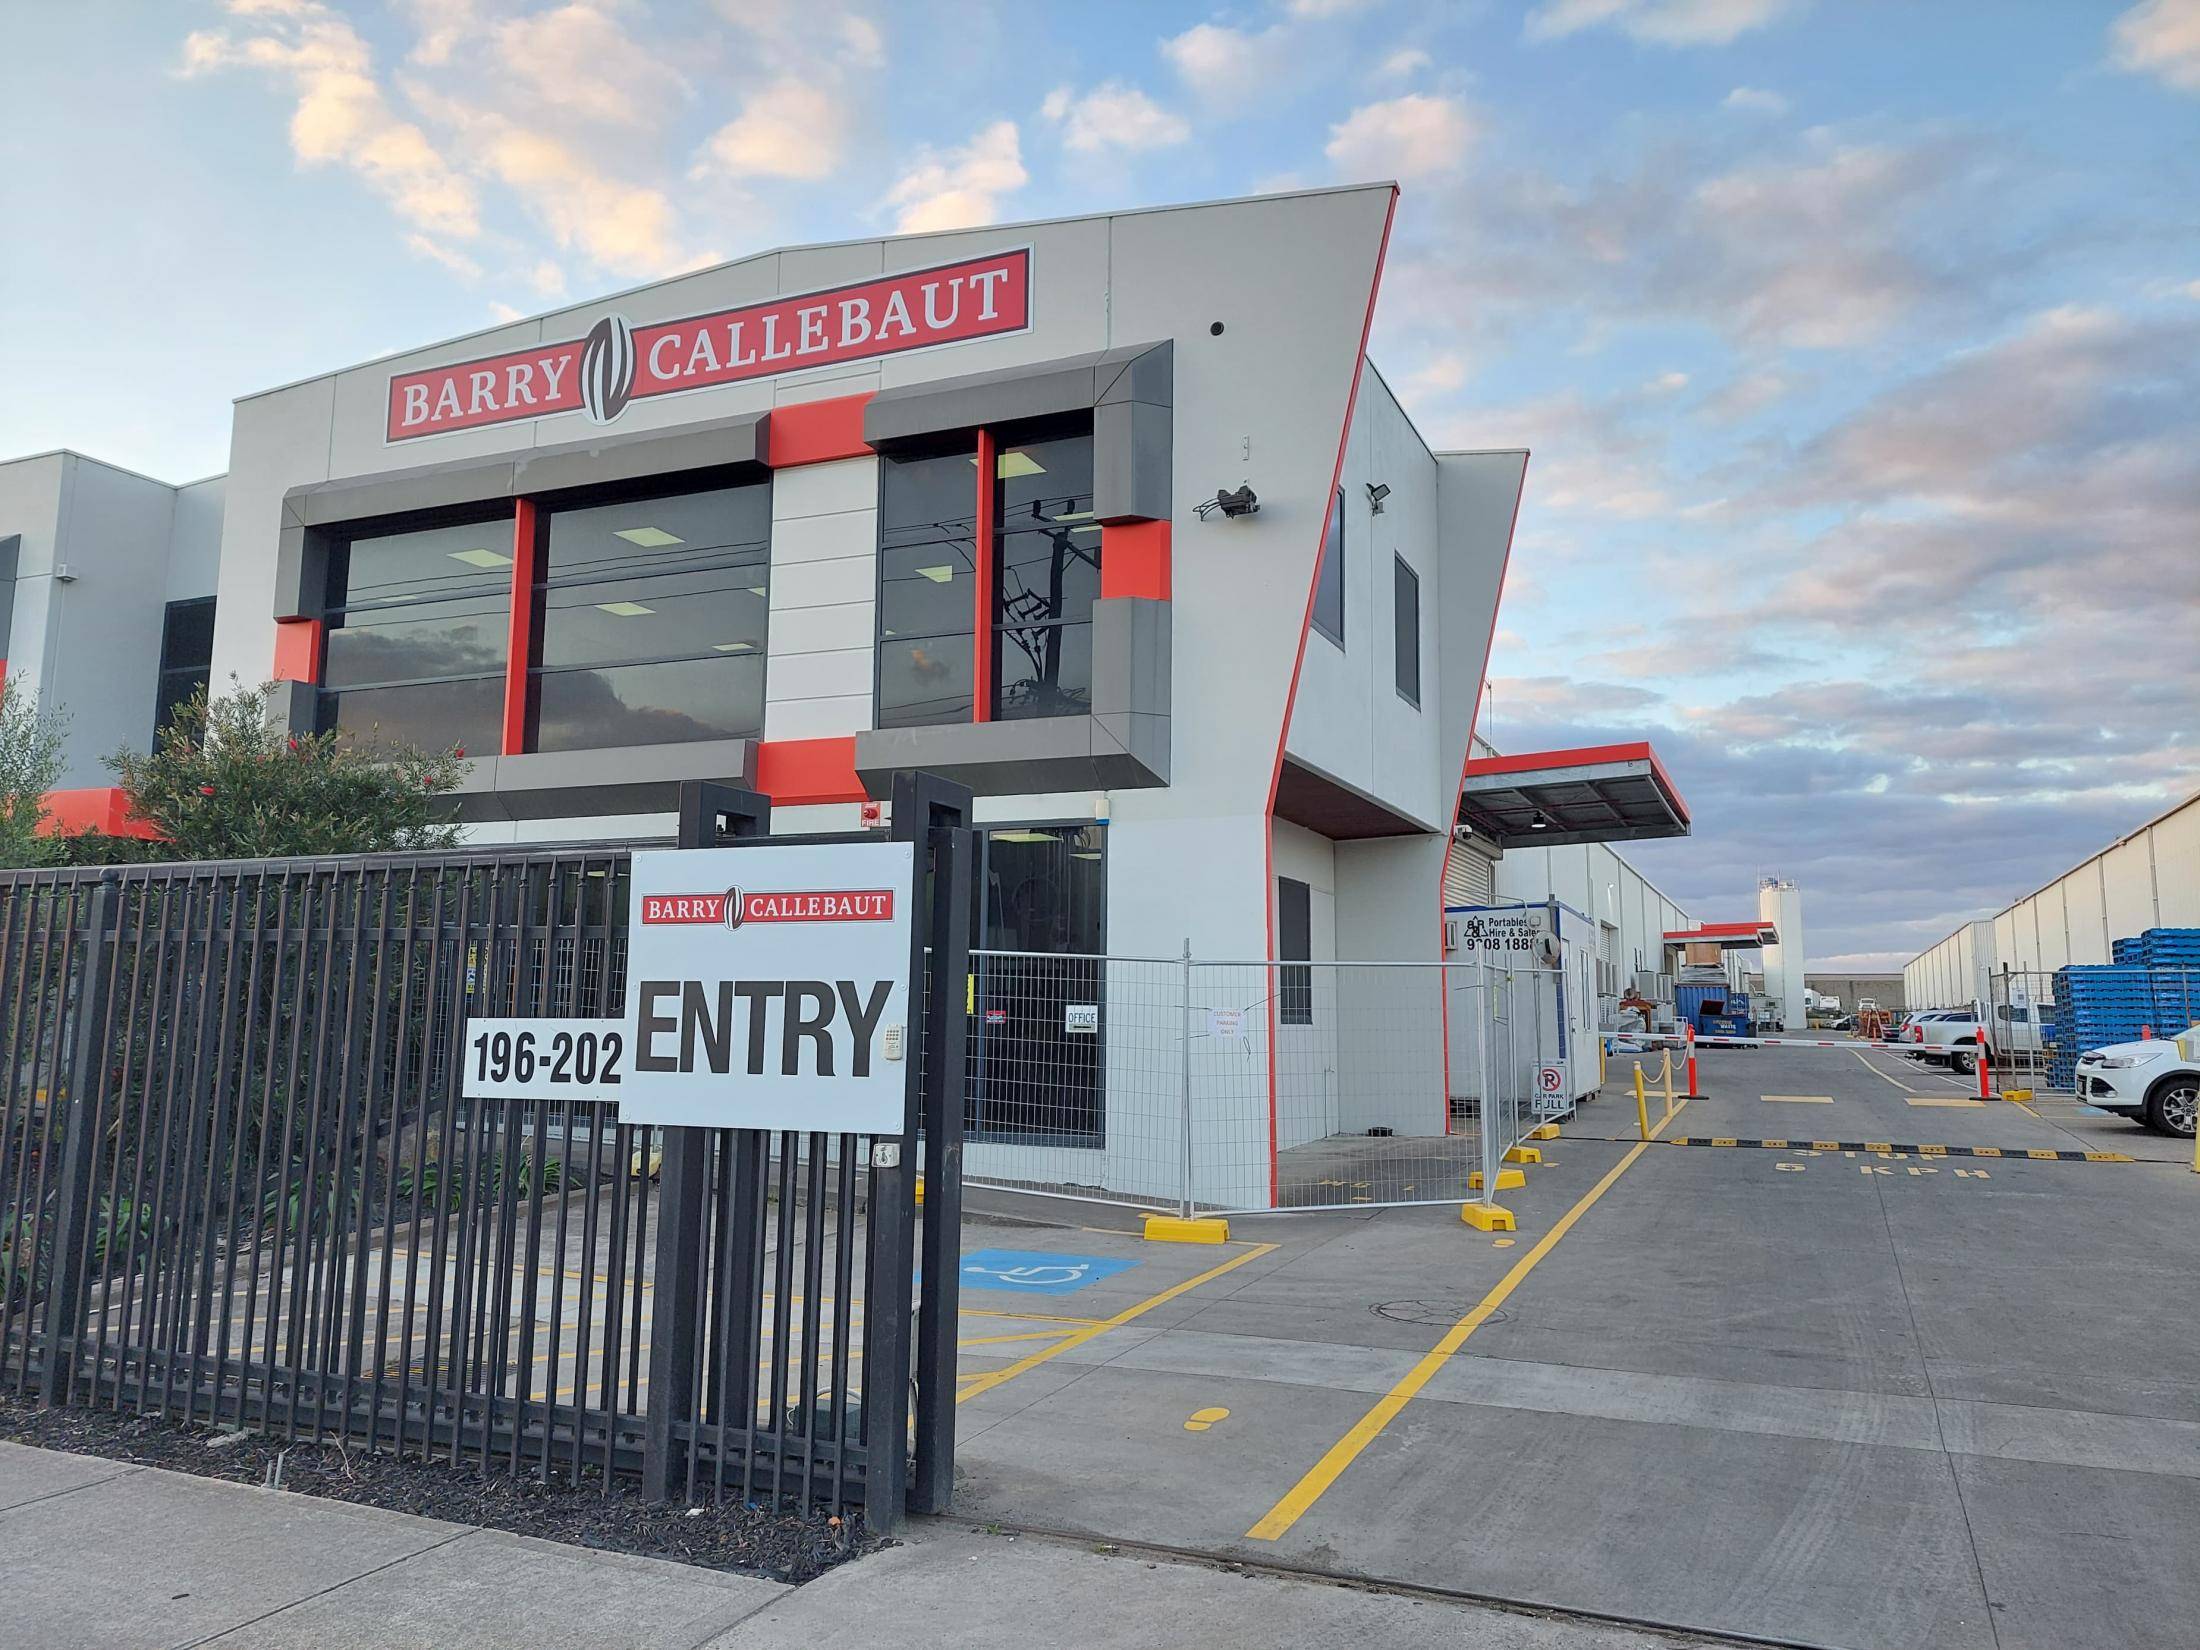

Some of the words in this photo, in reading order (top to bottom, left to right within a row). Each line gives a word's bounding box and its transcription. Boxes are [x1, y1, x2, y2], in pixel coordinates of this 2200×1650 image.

[402, 355, 571, 427] BARRY
[648, 268, 1008, 380] CALLEBAUT
[649, 899, 719, 919] BARRY
[751, 896, 886, 917] CALLEBAUT
[1467, 938, 1501, 950] 908
[1505, 938, 1537, 950] 188
[1489, 928, 1507, 937] Hire
[1509, 928, 1516, 937] &
[635, 980, 895, 1078] ENTRY
[1068, 1012, 1096, 1023] OFFICE
[474, 1031, 623, 1084] 196-202
